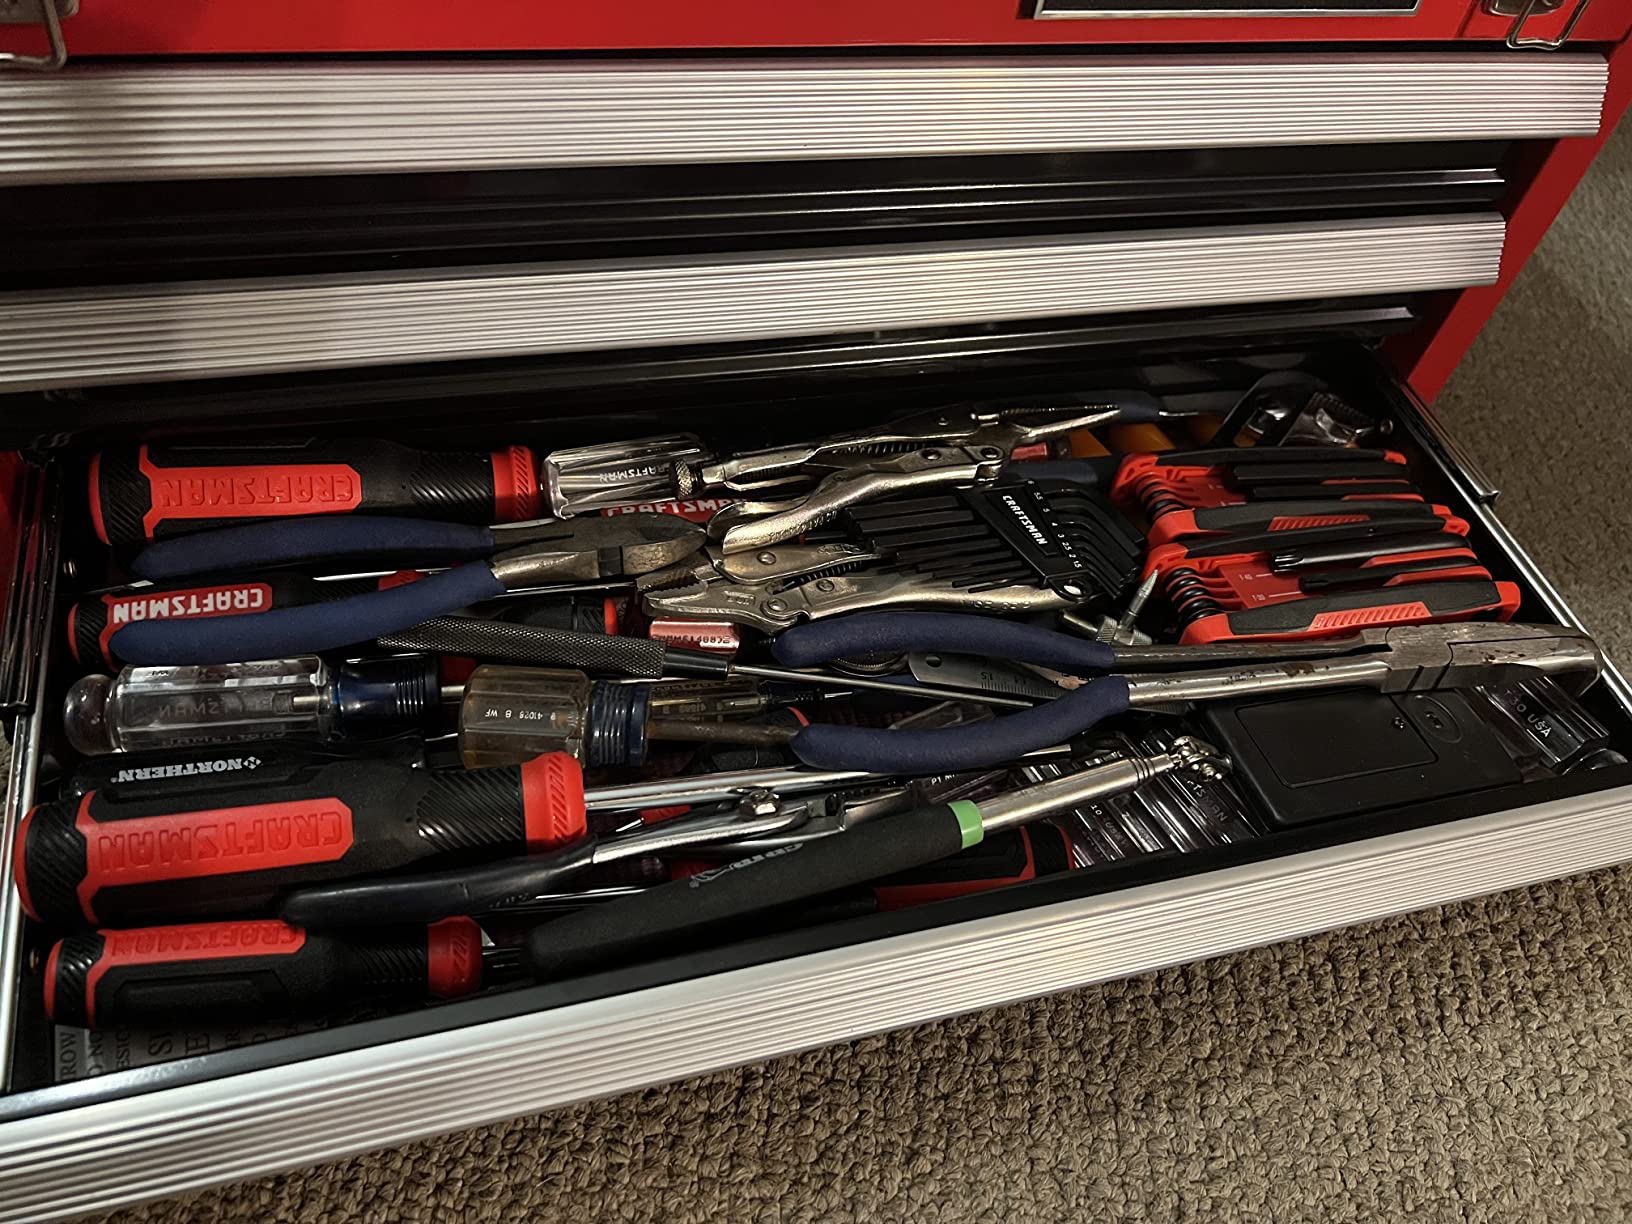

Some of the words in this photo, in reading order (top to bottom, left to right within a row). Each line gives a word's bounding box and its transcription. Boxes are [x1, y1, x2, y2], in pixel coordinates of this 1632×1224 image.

[599, 463, 670, 483] CRAFTSMAN
[160, 474, 355, 509] CRAFTSMAN
[1002, 495, 1048, 545] CRAFTSMAN
[112, 586, 264, 625] CRAFTSMAN
[485, 708, 498, 718] WF
[1527, 712, 1552, 739] USA
[116, 757, 243, 783] NORTHERN
[98, 810, 344, 873] CRAFTSMAN
[110, 924, 299, 957] CRAFTSMAN
